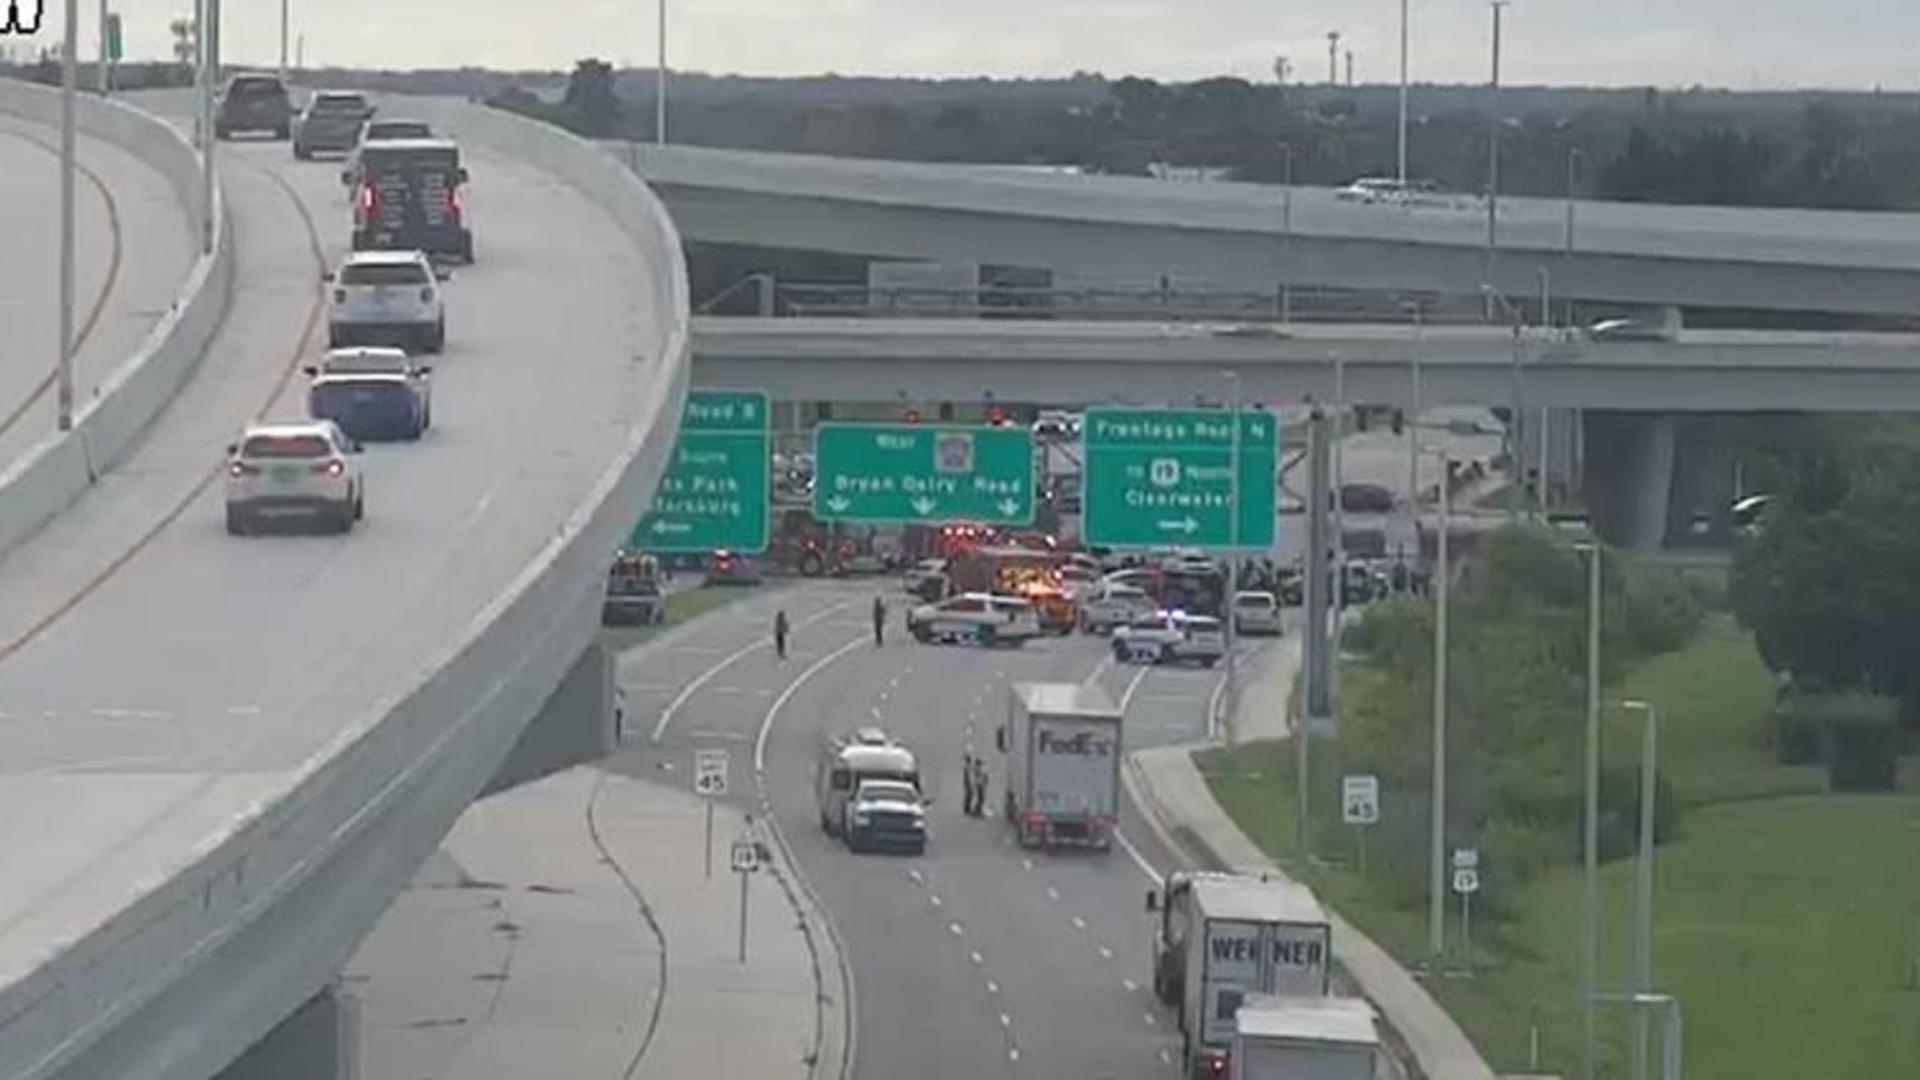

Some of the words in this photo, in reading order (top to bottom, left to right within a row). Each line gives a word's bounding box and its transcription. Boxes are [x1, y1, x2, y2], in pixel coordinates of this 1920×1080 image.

[1195, 421, 1240, 439] Roa
[834, 474, 894, 493] Bryan
[1039, 729, 1112, 758] FedEx
[699, 774, 725, 790] 45
[1348, 802, 1373, 818] 45
